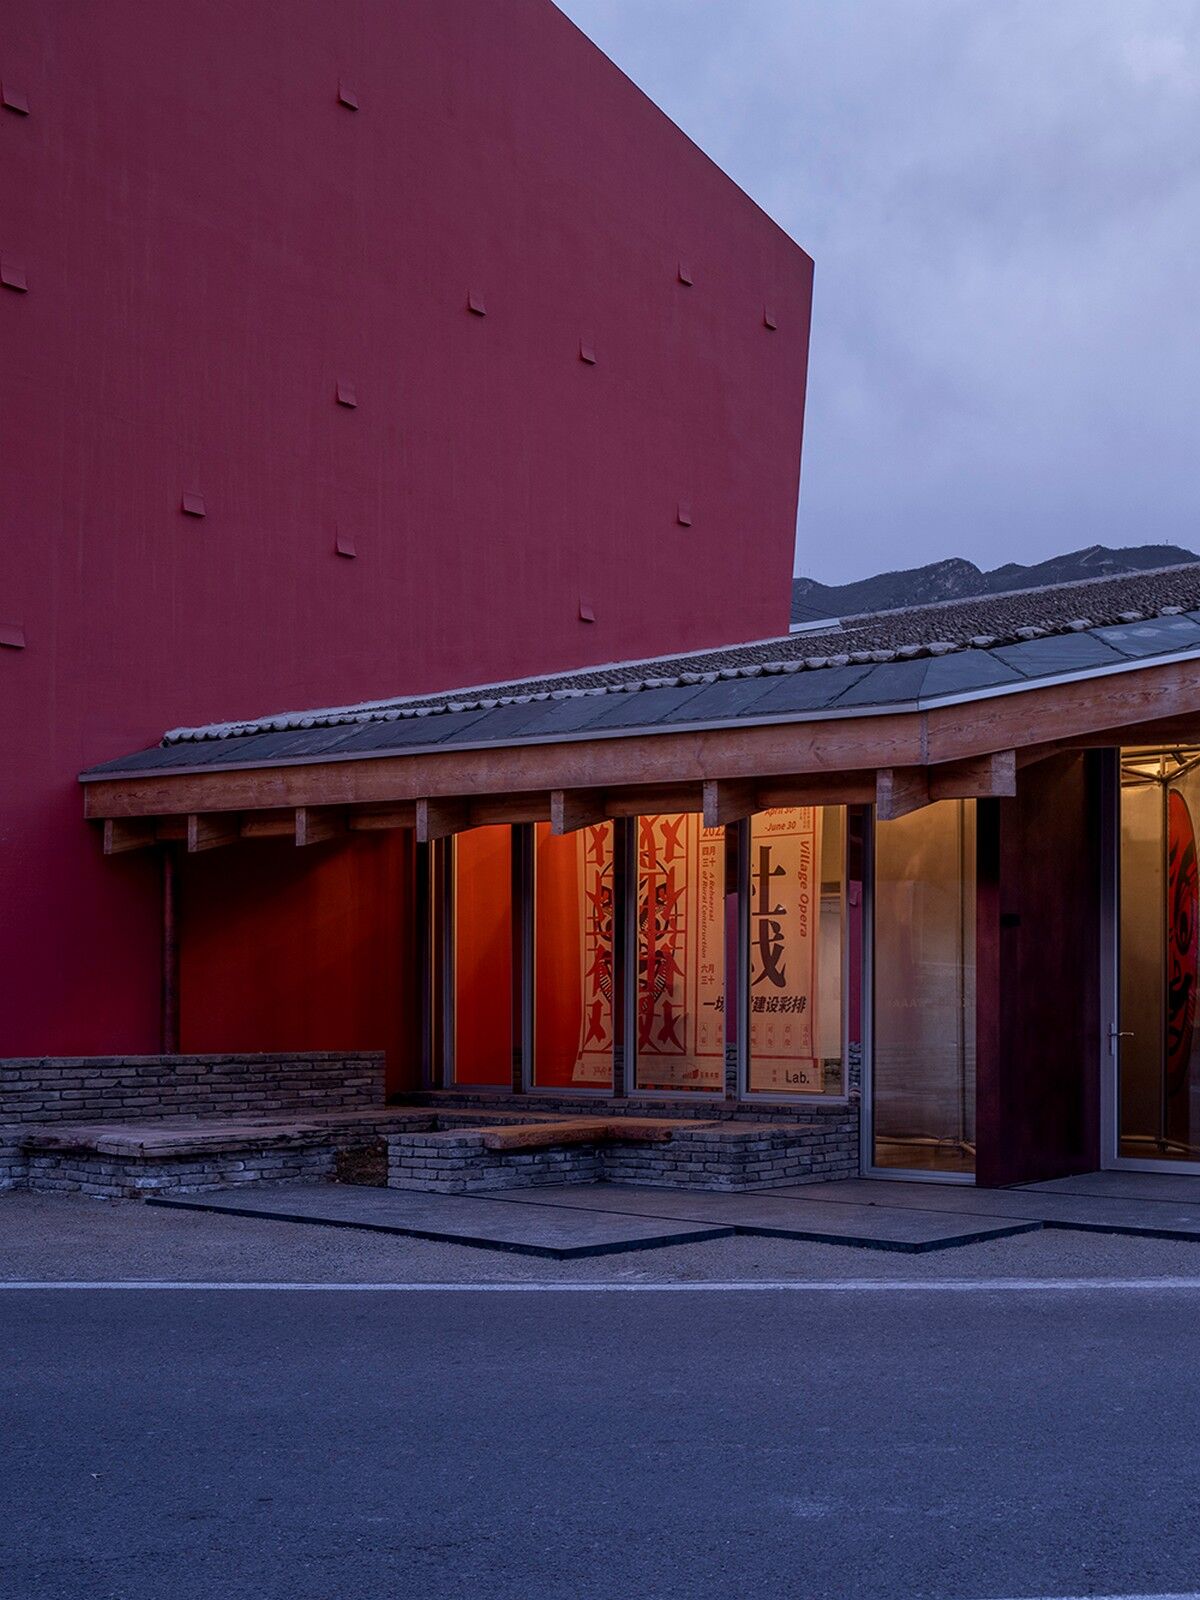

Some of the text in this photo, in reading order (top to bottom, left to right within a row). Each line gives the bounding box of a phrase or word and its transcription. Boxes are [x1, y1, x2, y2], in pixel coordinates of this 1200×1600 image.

[787, 820, 797, 830] 30
[702, 827, 725, 837] 202
[798, 840, 810, 890] Village
[702, 870, 709, 880] of
[798, 893, 810, 938] Opera
[785, 1069, 810, 1084] Lab.
